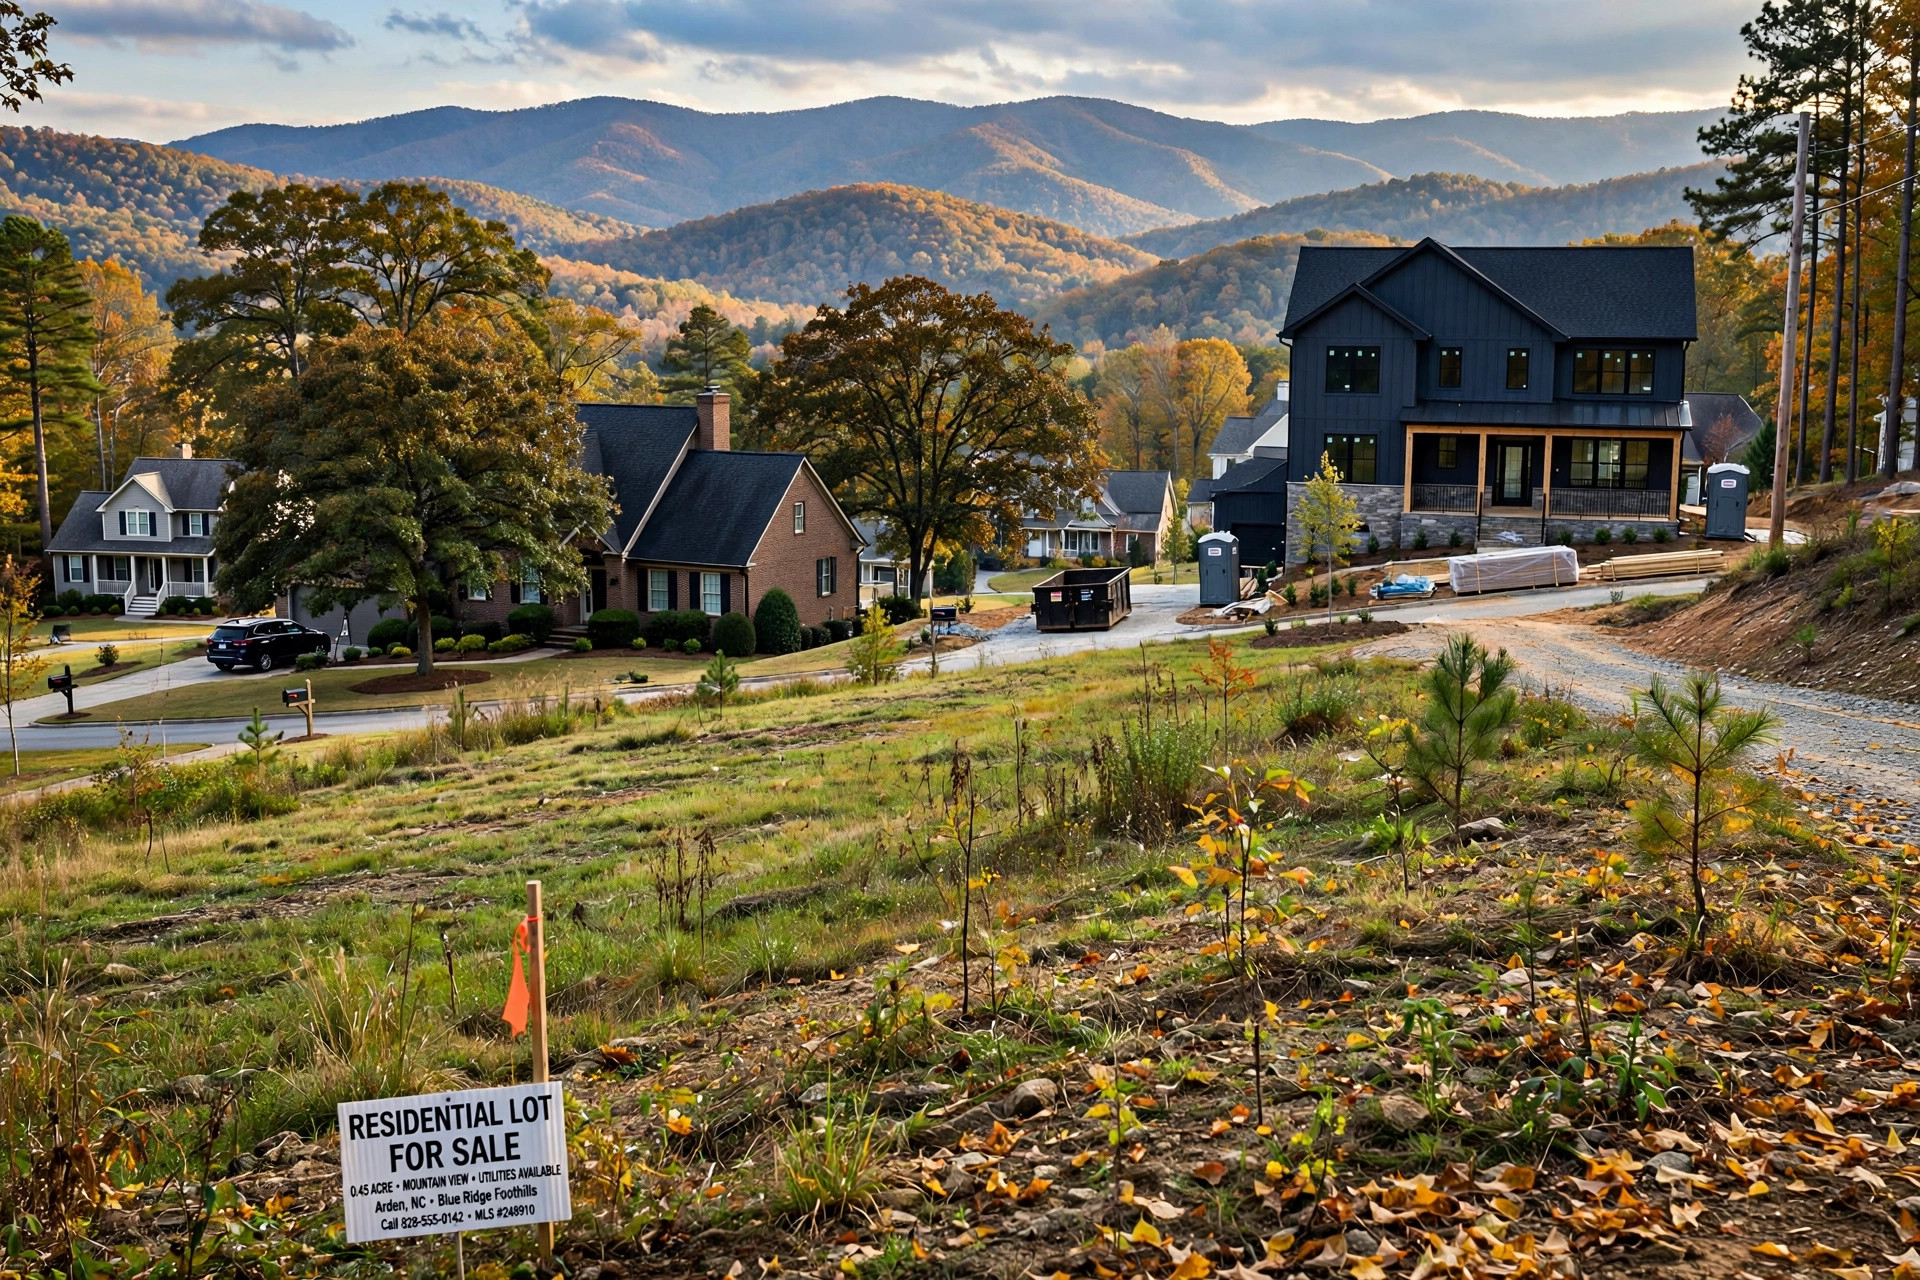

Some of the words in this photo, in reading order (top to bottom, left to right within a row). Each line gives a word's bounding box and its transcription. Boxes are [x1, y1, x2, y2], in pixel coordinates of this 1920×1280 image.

[349, 1101, 504, 1140] RESIDENTIAL
[510, 1095, 552, 1124] LOT
[390, 1140, 444, 1173] FOR
[452, 1132, 521, 1166] SALE
[350, 1184, 369, 1197] 0.45
[370, 1181, 393, 1195] ACRE
[402, 1175, 447, 1191] MOUNTAIN
[448, 1173, 469, 1186] VIEW
[478, 1168, 516, 1183] UTILITIES
[518, 1164, 562, 1179] AVAILABLE
[375, 1199, 408, 1213] Arden,
[411, 1195, 426, 1209] NC
[438, 1193, 461, 1207] Blue
[463, 1190, 492, 1205] Ridge
[494, 1184, 538, 1200] Foothills
[381, 1217, 399, 1230] Call
[401, 1211, 464, 1229] 828-555-0142
[475, 1207, 494, 1221] MLS
[496, 1204, 535, 1218] #248910
